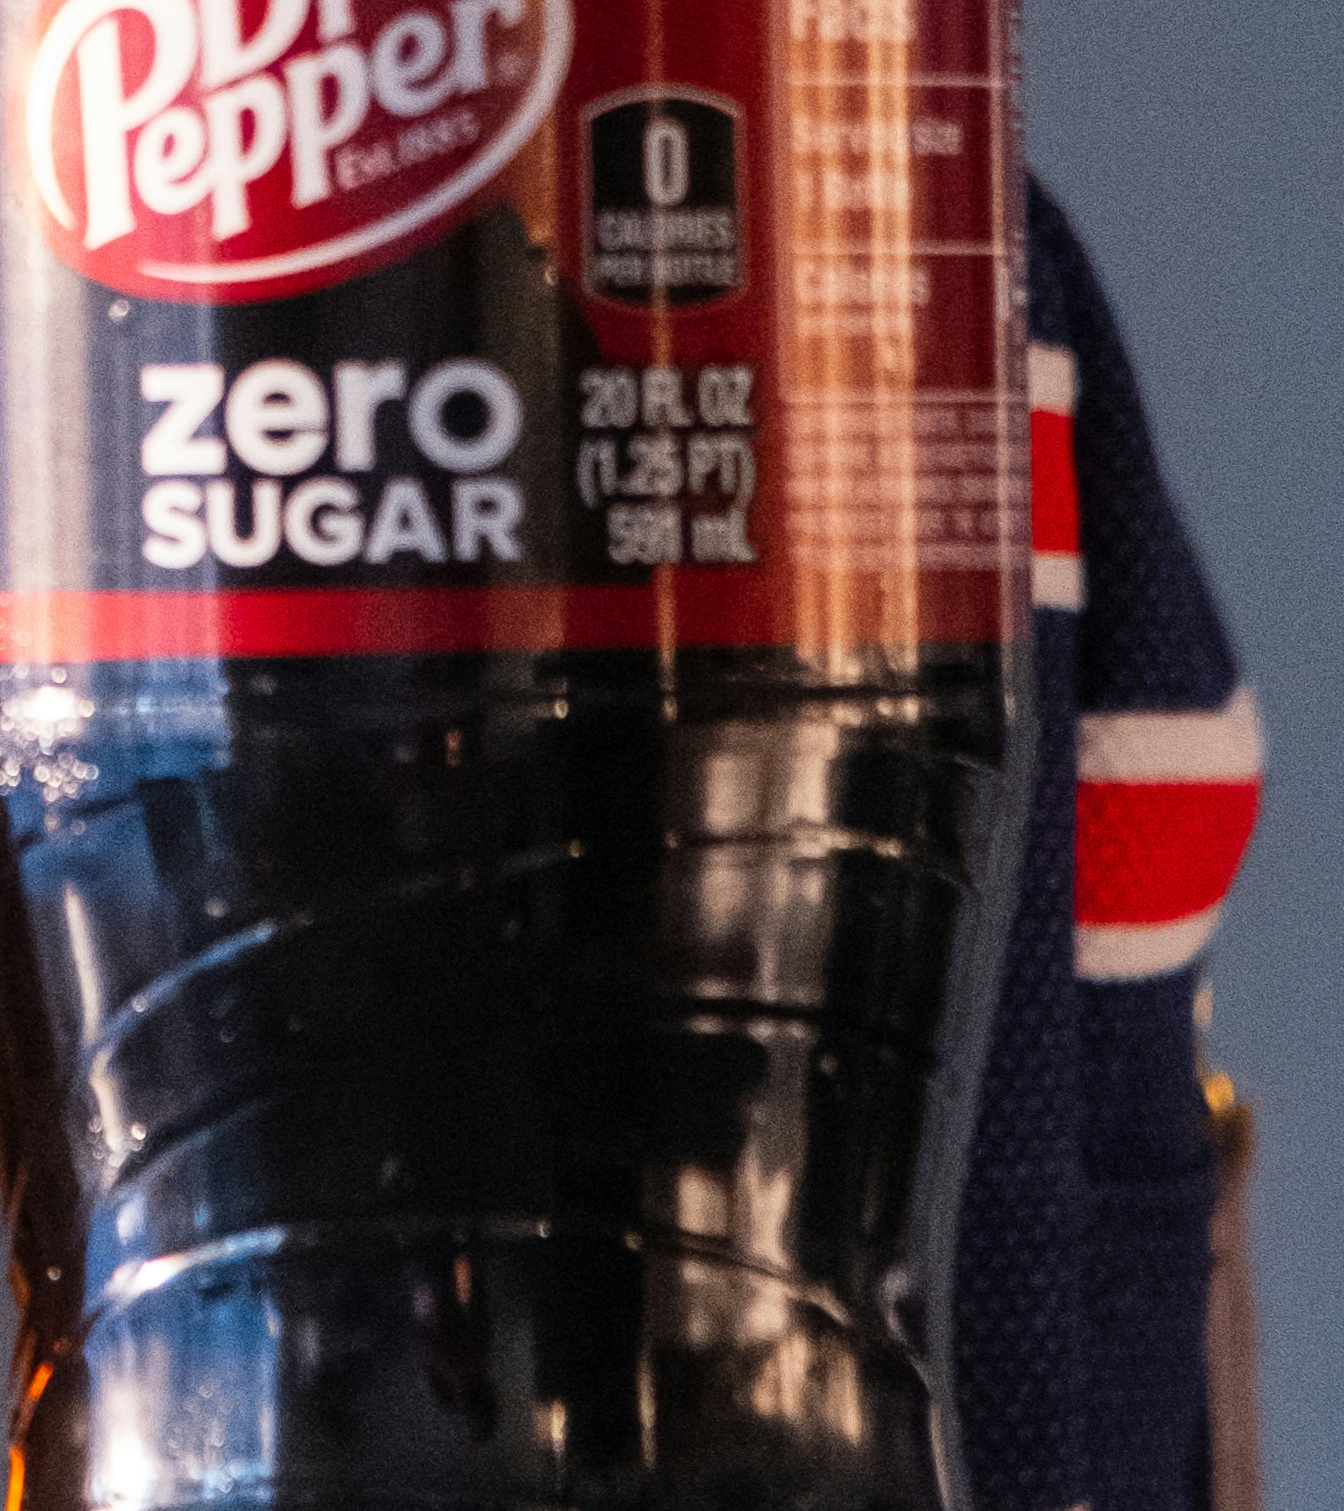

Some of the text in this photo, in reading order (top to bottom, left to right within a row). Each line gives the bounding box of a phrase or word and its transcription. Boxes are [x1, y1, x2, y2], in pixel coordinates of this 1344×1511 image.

[643, 117, 688, 206] 0
[140, 357, 525, 476] zero
[580, 369, 638, 429] 20
[140, 477, 525, 569] SUGAR
